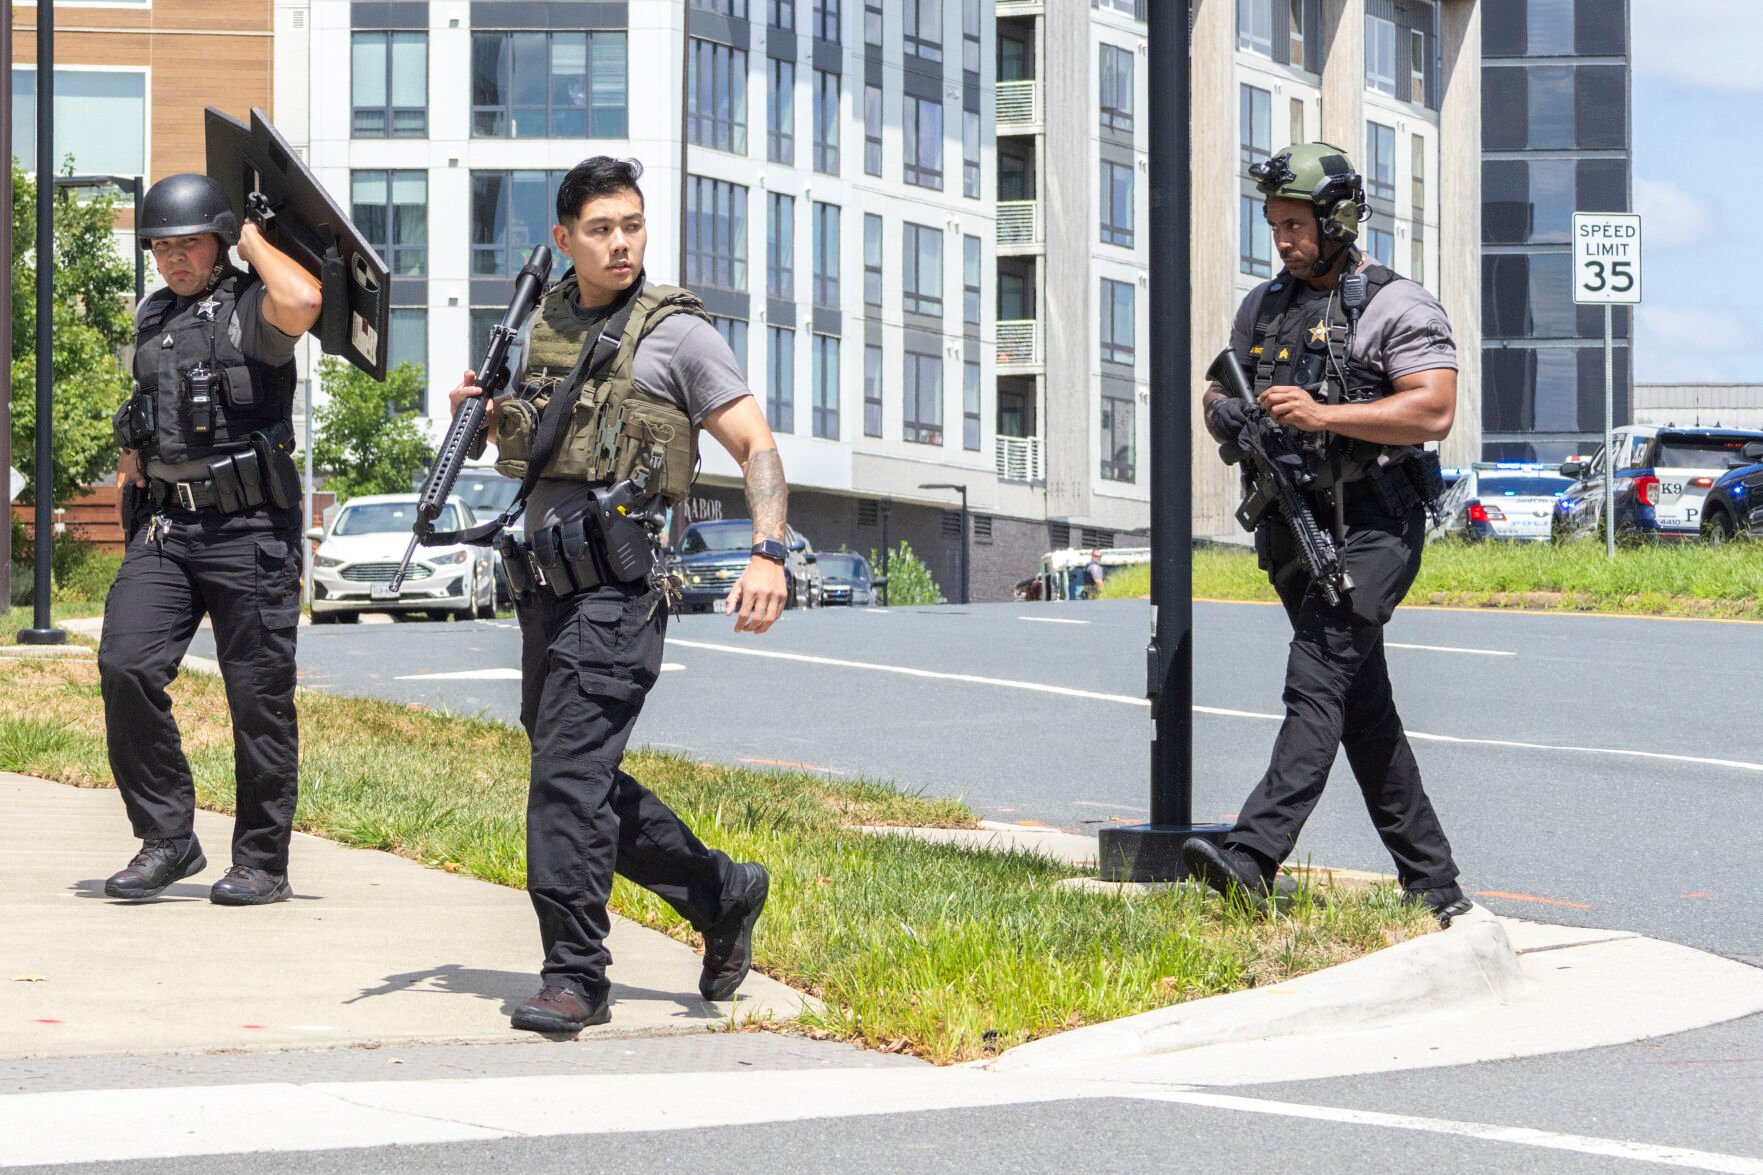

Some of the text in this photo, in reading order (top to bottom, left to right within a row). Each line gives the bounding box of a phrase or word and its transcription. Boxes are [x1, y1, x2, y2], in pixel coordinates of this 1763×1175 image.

[1580, 225, 1636, 238] SPEED
[1586, 243, 1629, 256] LIMIT
[1583, 260, 1634, 292] 35
[1661, 483, 1682, 495] K9
[684, 497, 722, 522] KABOB
